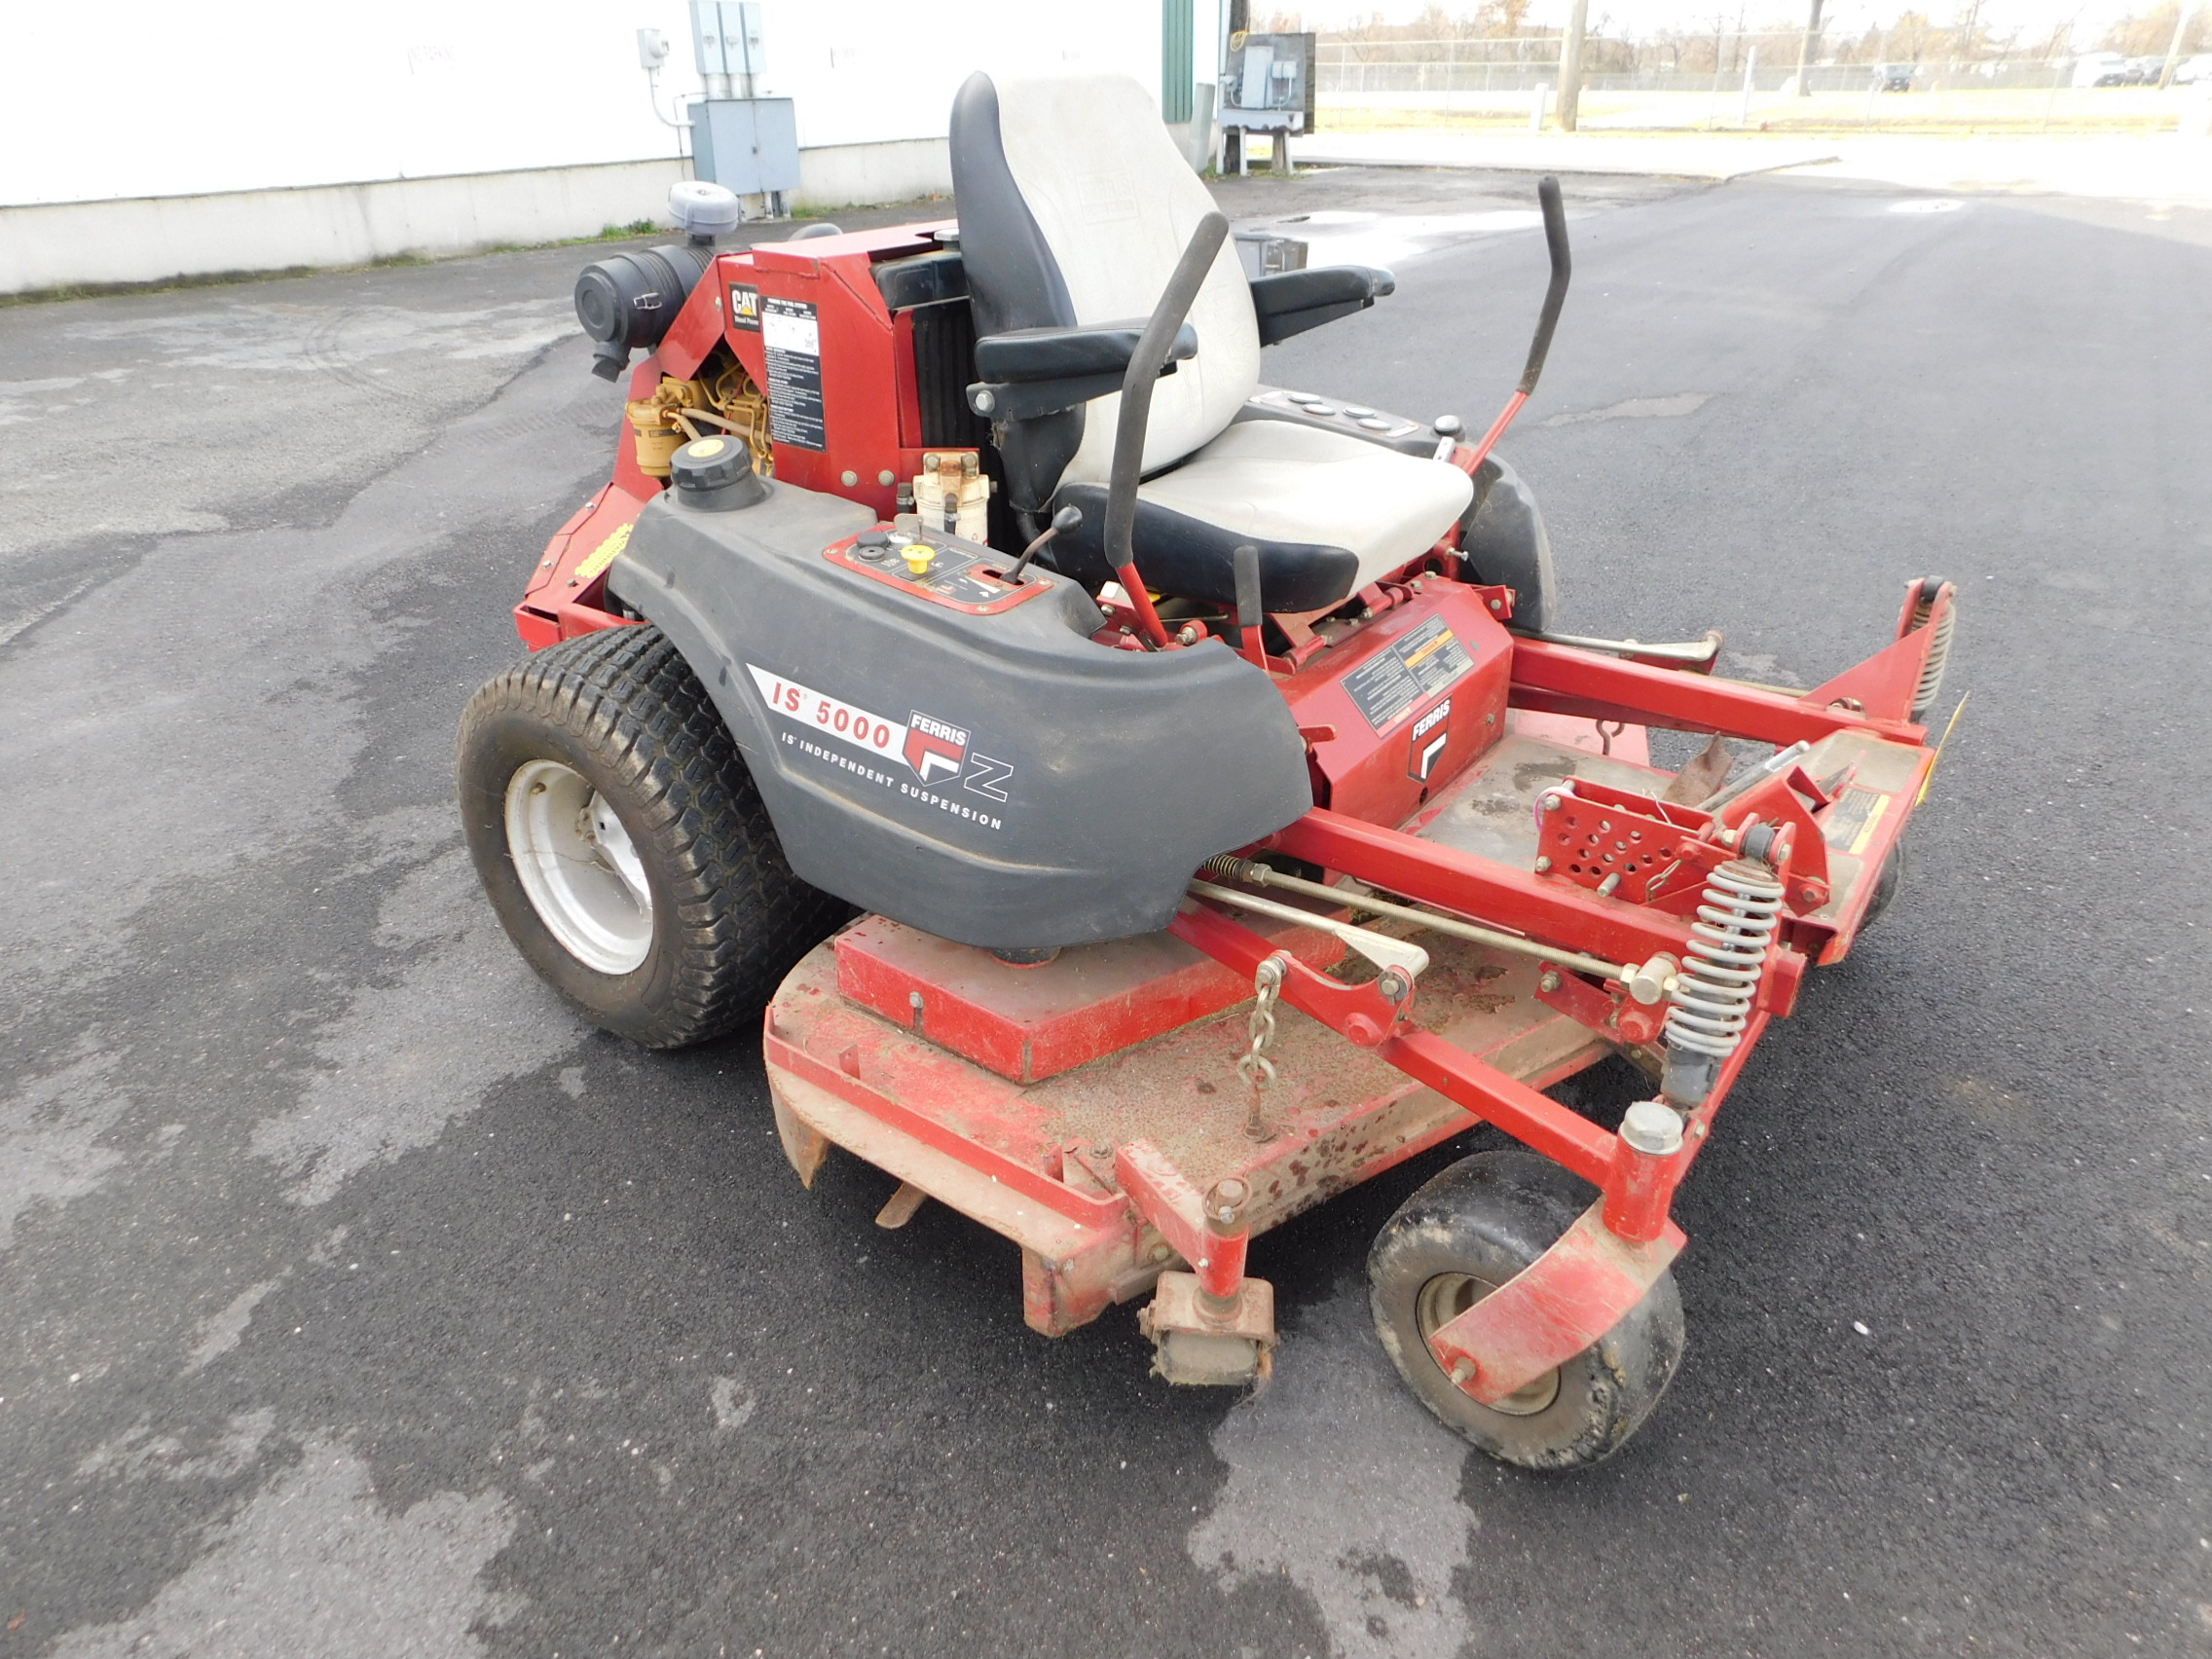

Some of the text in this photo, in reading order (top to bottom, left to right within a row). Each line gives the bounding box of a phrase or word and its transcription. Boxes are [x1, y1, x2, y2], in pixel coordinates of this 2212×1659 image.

[732, 290, 758, 316] CAT
[773, 682, 890, 749] IS 5000
[910, 714, 967, 746] FERRIS
[1413, 699, 1451, 741] FERRIS
[799, 740, 894, 787] INDEPENDENT
[901, 783, 1002, 830] SUSPENSION
